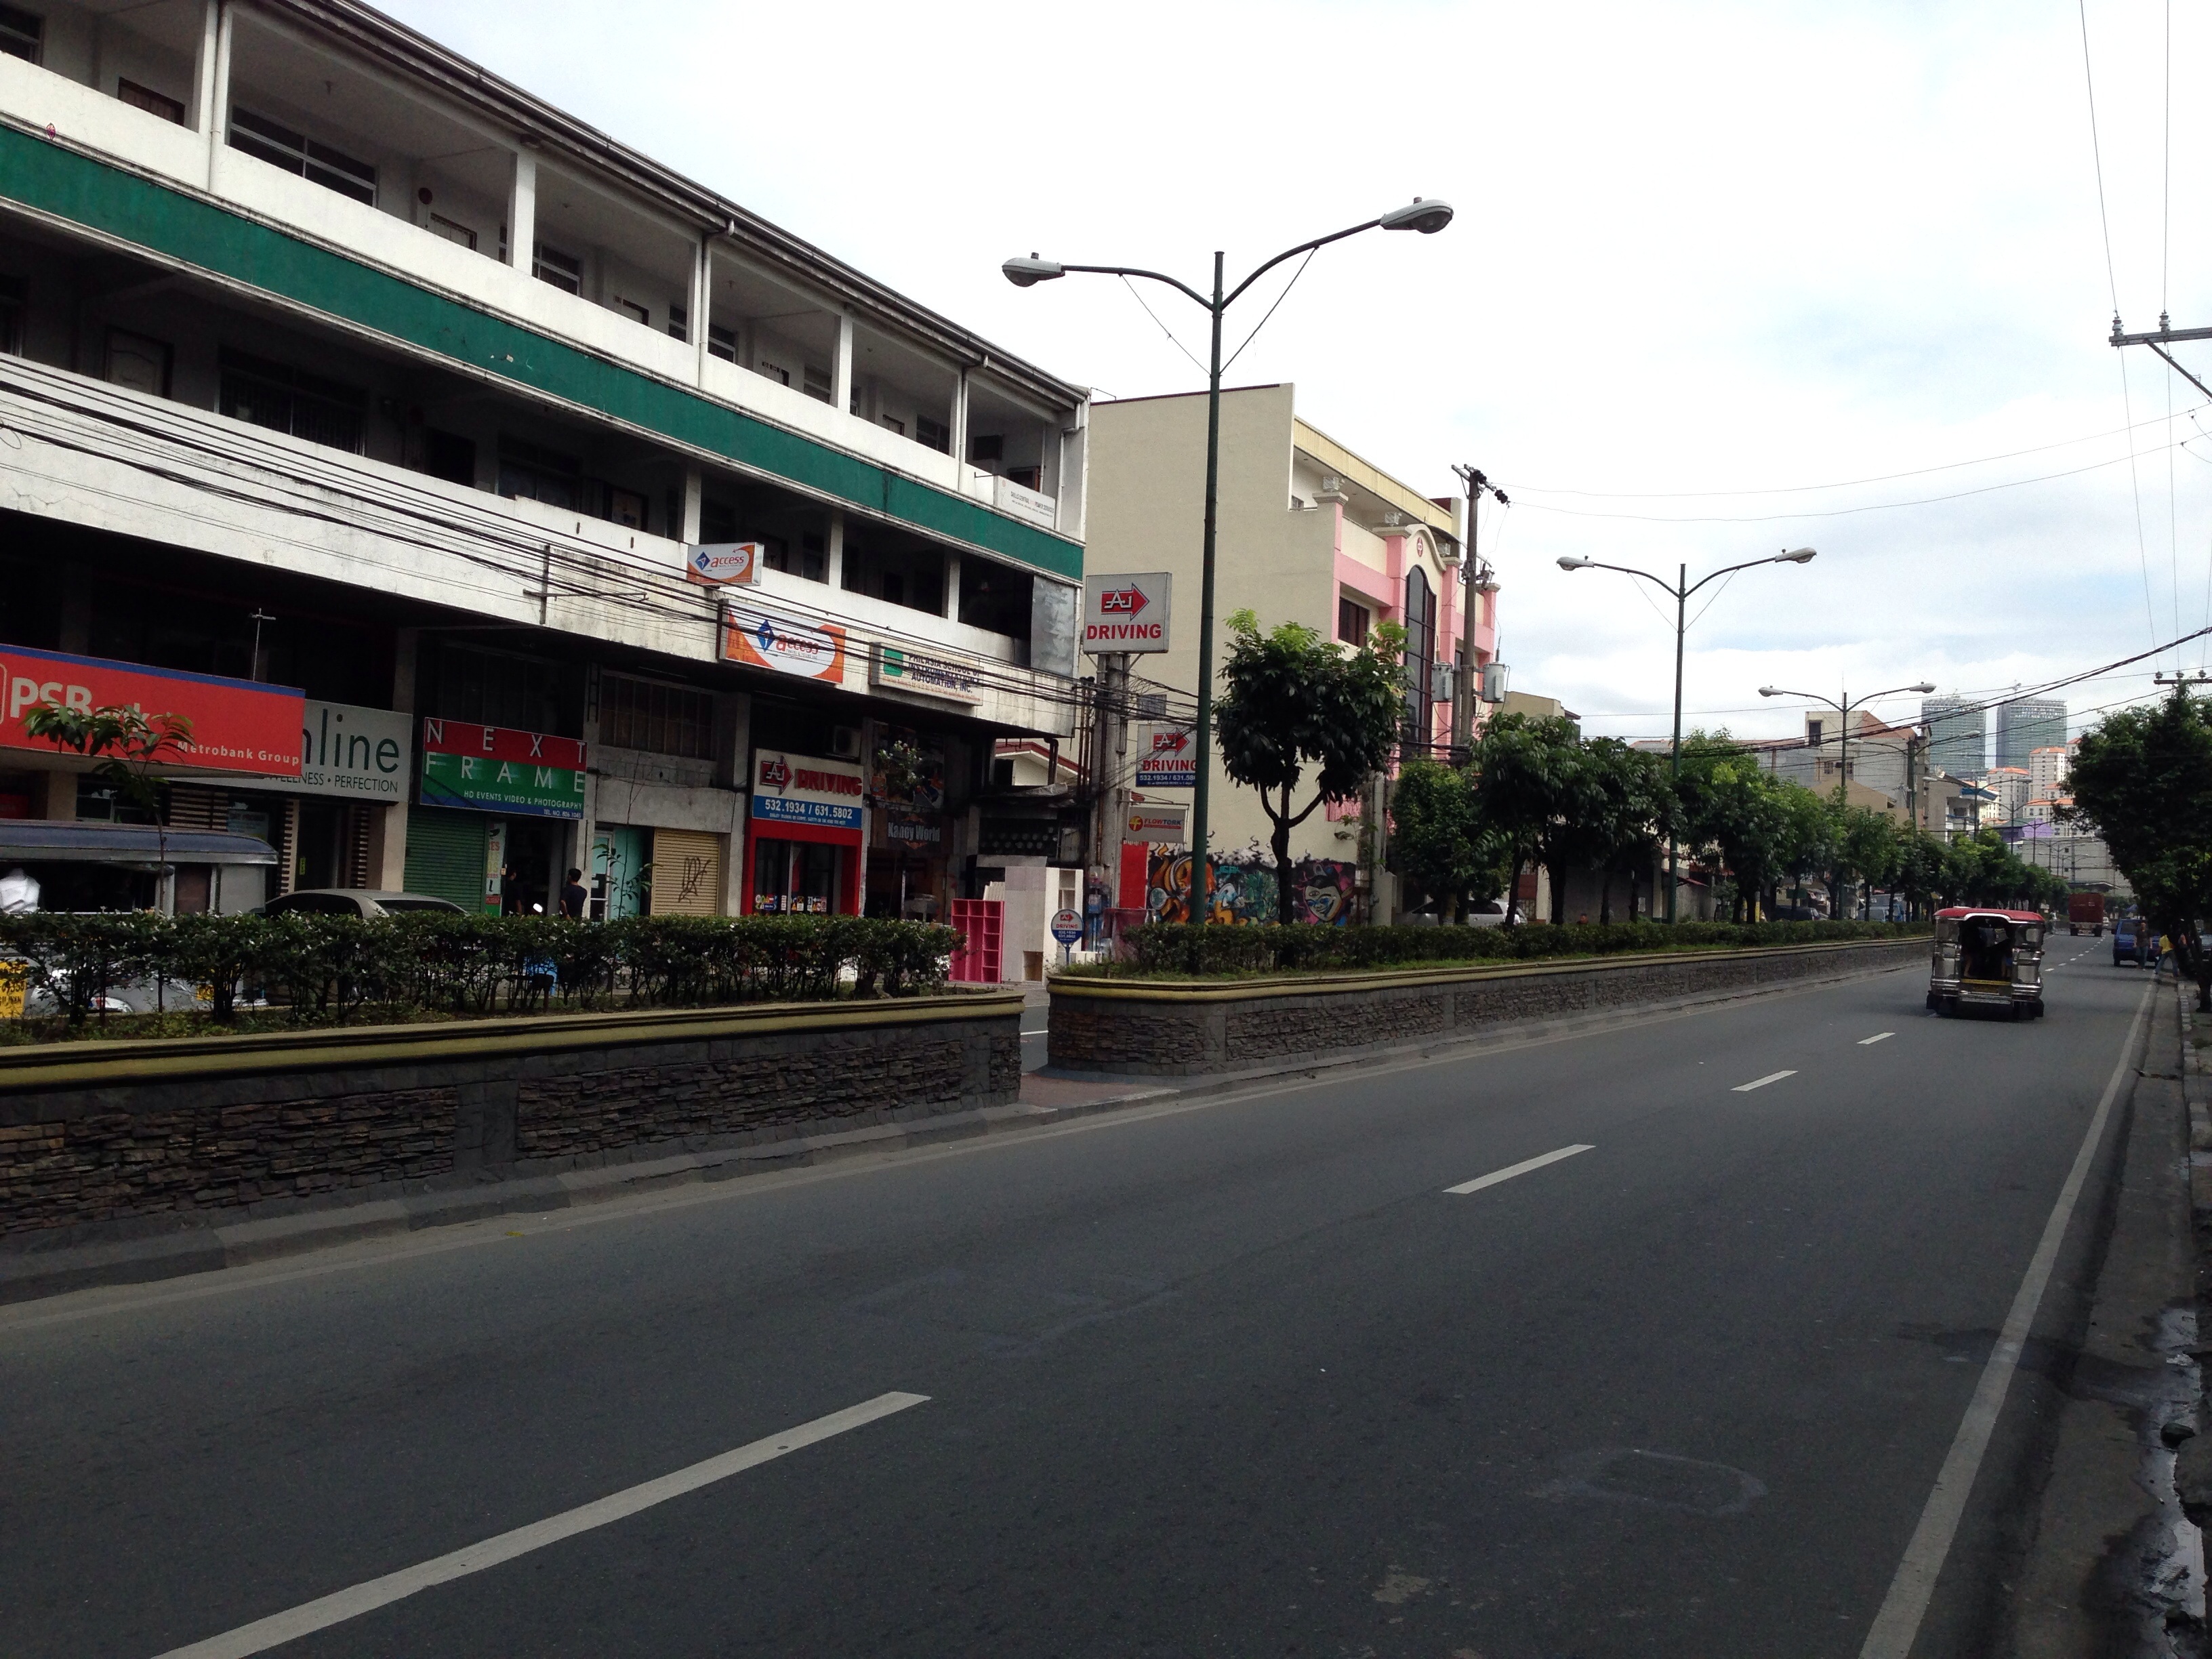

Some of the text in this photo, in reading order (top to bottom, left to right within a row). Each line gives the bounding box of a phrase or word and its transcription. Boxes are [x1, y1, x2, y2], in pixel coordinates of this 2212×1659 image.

[710, 556, 744, 567] access
[1104, 588, 1132, 609] AJ
[1086, 623, 1162, 640] DRIVING
[776, 634, 819, 655] access
[427, 719, 586, 764] NEXT
[177, 741, 300, 766] Metrobank Group
[426, 752, 586, 793] FRAME
[796, 769, 863, 796] DRIVING
[334, 775, 398, 793] PERFECTION
[464, 790, 474, 798] HD
[476, 792, 501, 801] EVENTS
[504, 794, 525, 804] VIDEO
[534, 798, 583, 810] PHOTOGRAPHY
[765, 799, 805, 813] 532.1934
[815, 804, 853, 819] 631.5802
[915, 825, 941, 842] World
